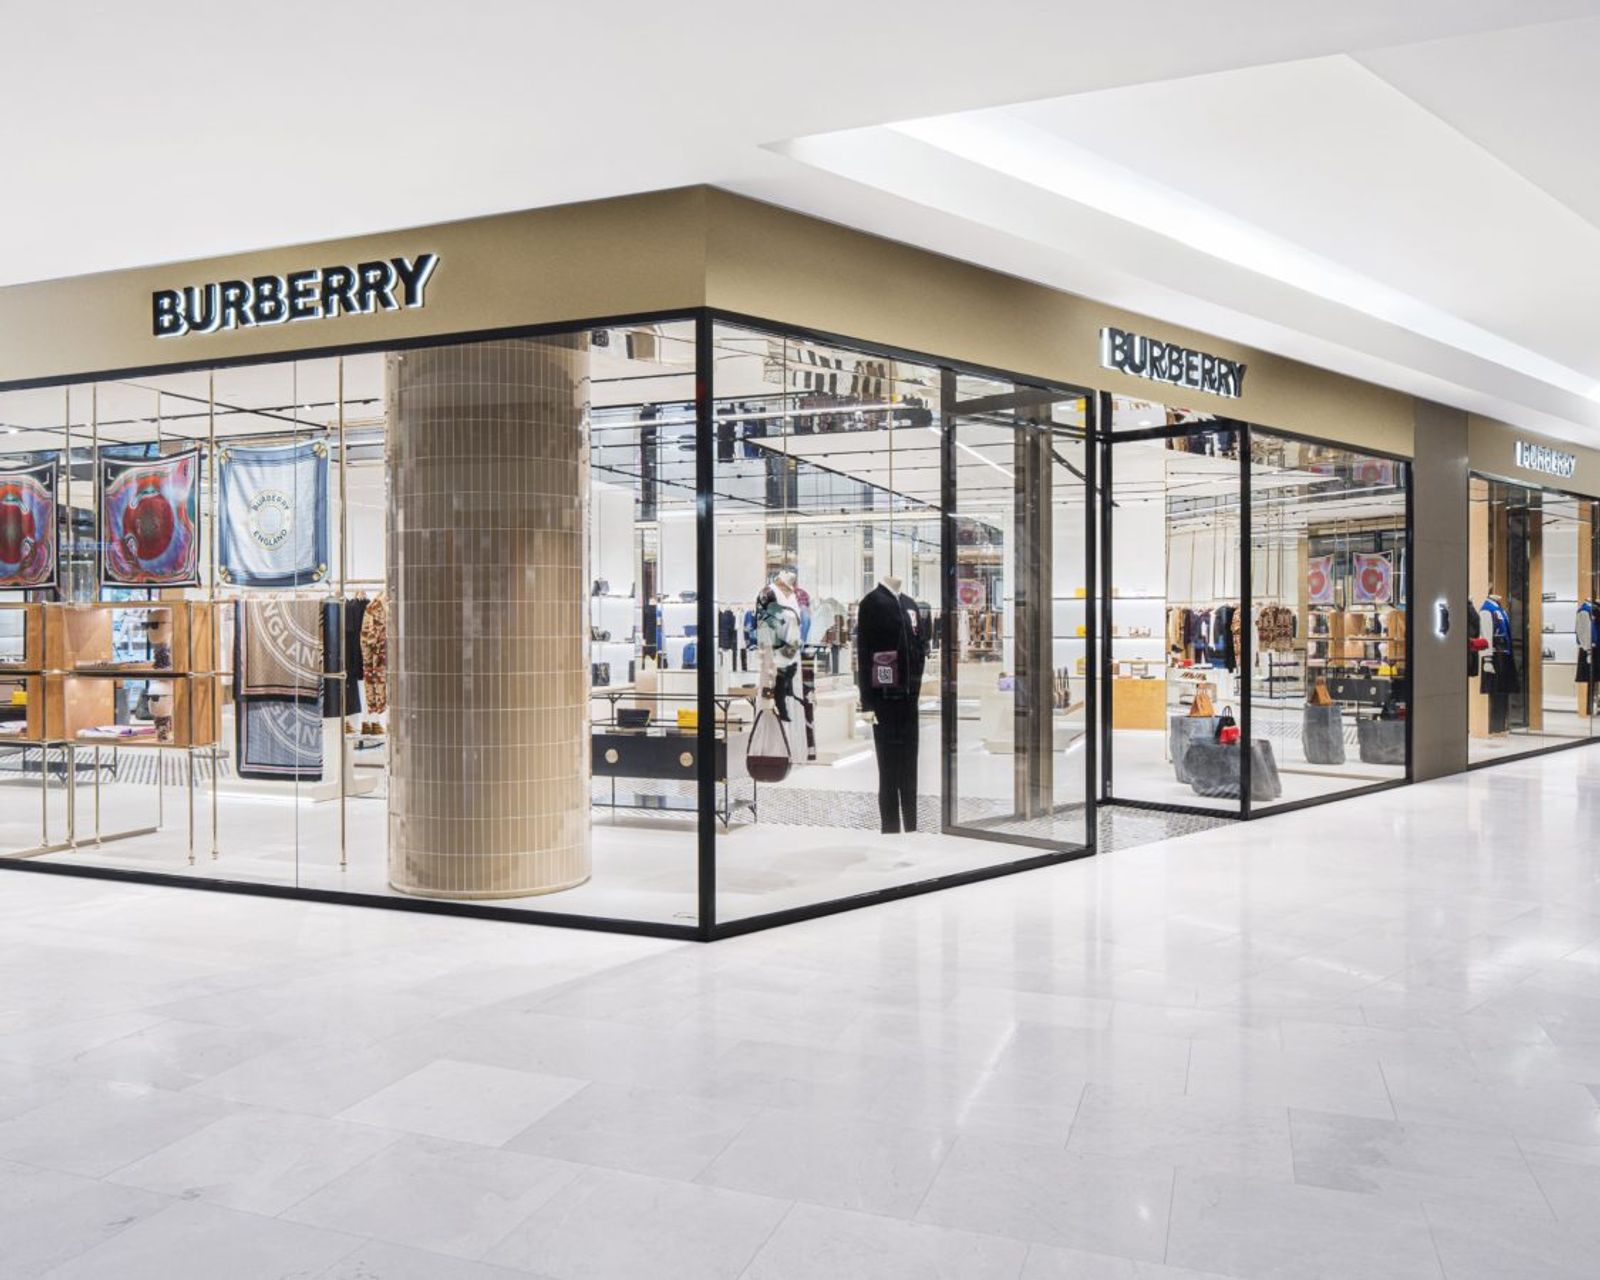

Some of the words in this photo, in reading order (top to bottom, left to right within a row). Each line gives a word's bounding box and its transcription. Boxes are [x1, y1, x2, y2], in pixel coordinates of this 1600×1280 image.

[152, 253, 439, 337] BURBERRY
[1101, 327, 1247, 398] BURBERRY
[253, 529, 287, 546] ENGLAND
